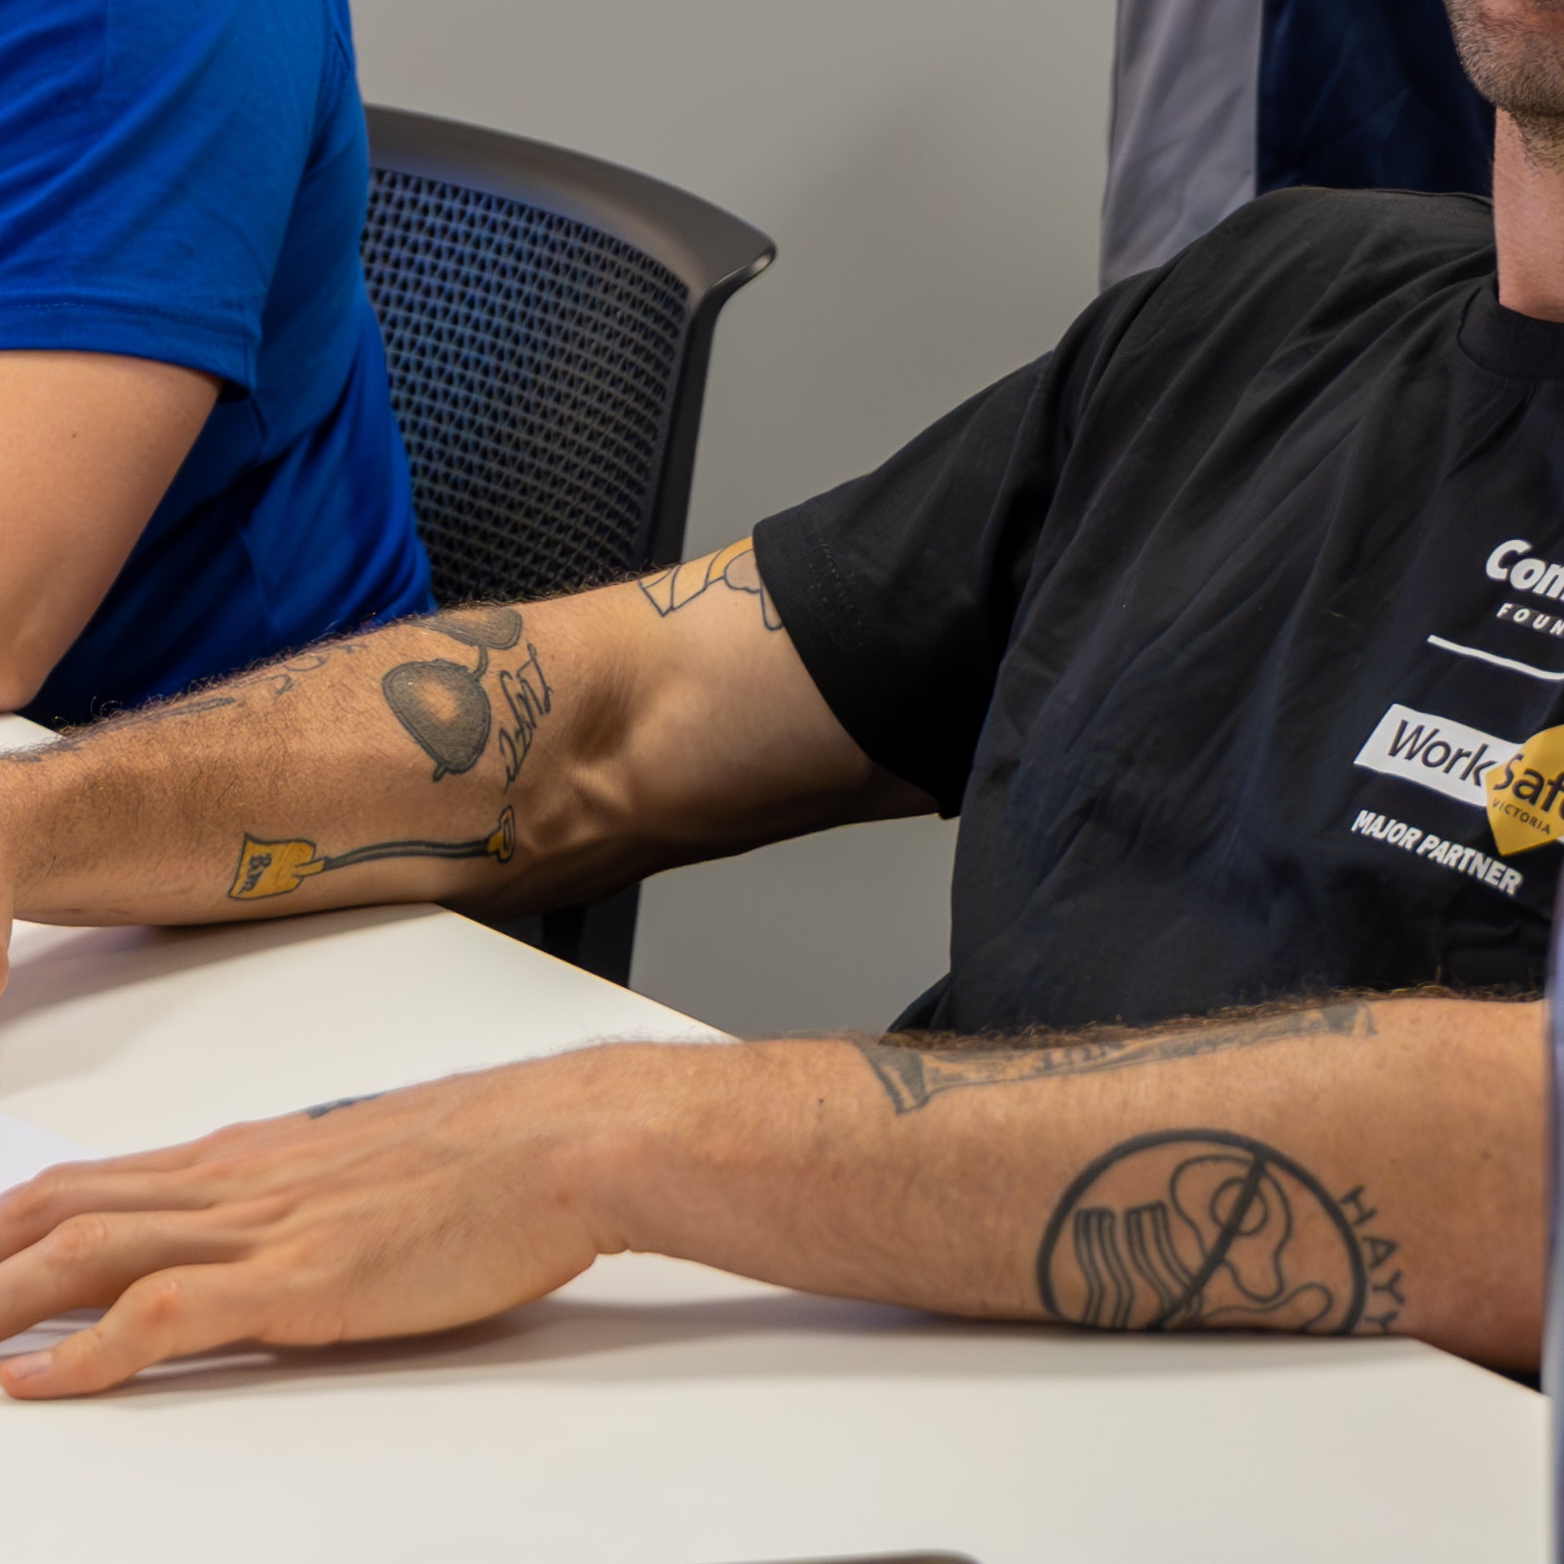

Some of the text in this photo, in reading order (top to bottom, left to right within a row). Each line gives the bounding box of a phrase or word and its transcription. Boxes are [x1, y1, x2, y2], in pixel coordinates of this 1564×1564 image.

[1492, 797, 1551, 836] VICTORIA
[1351, 809, 1524, 897] MAJOR PARTNER
